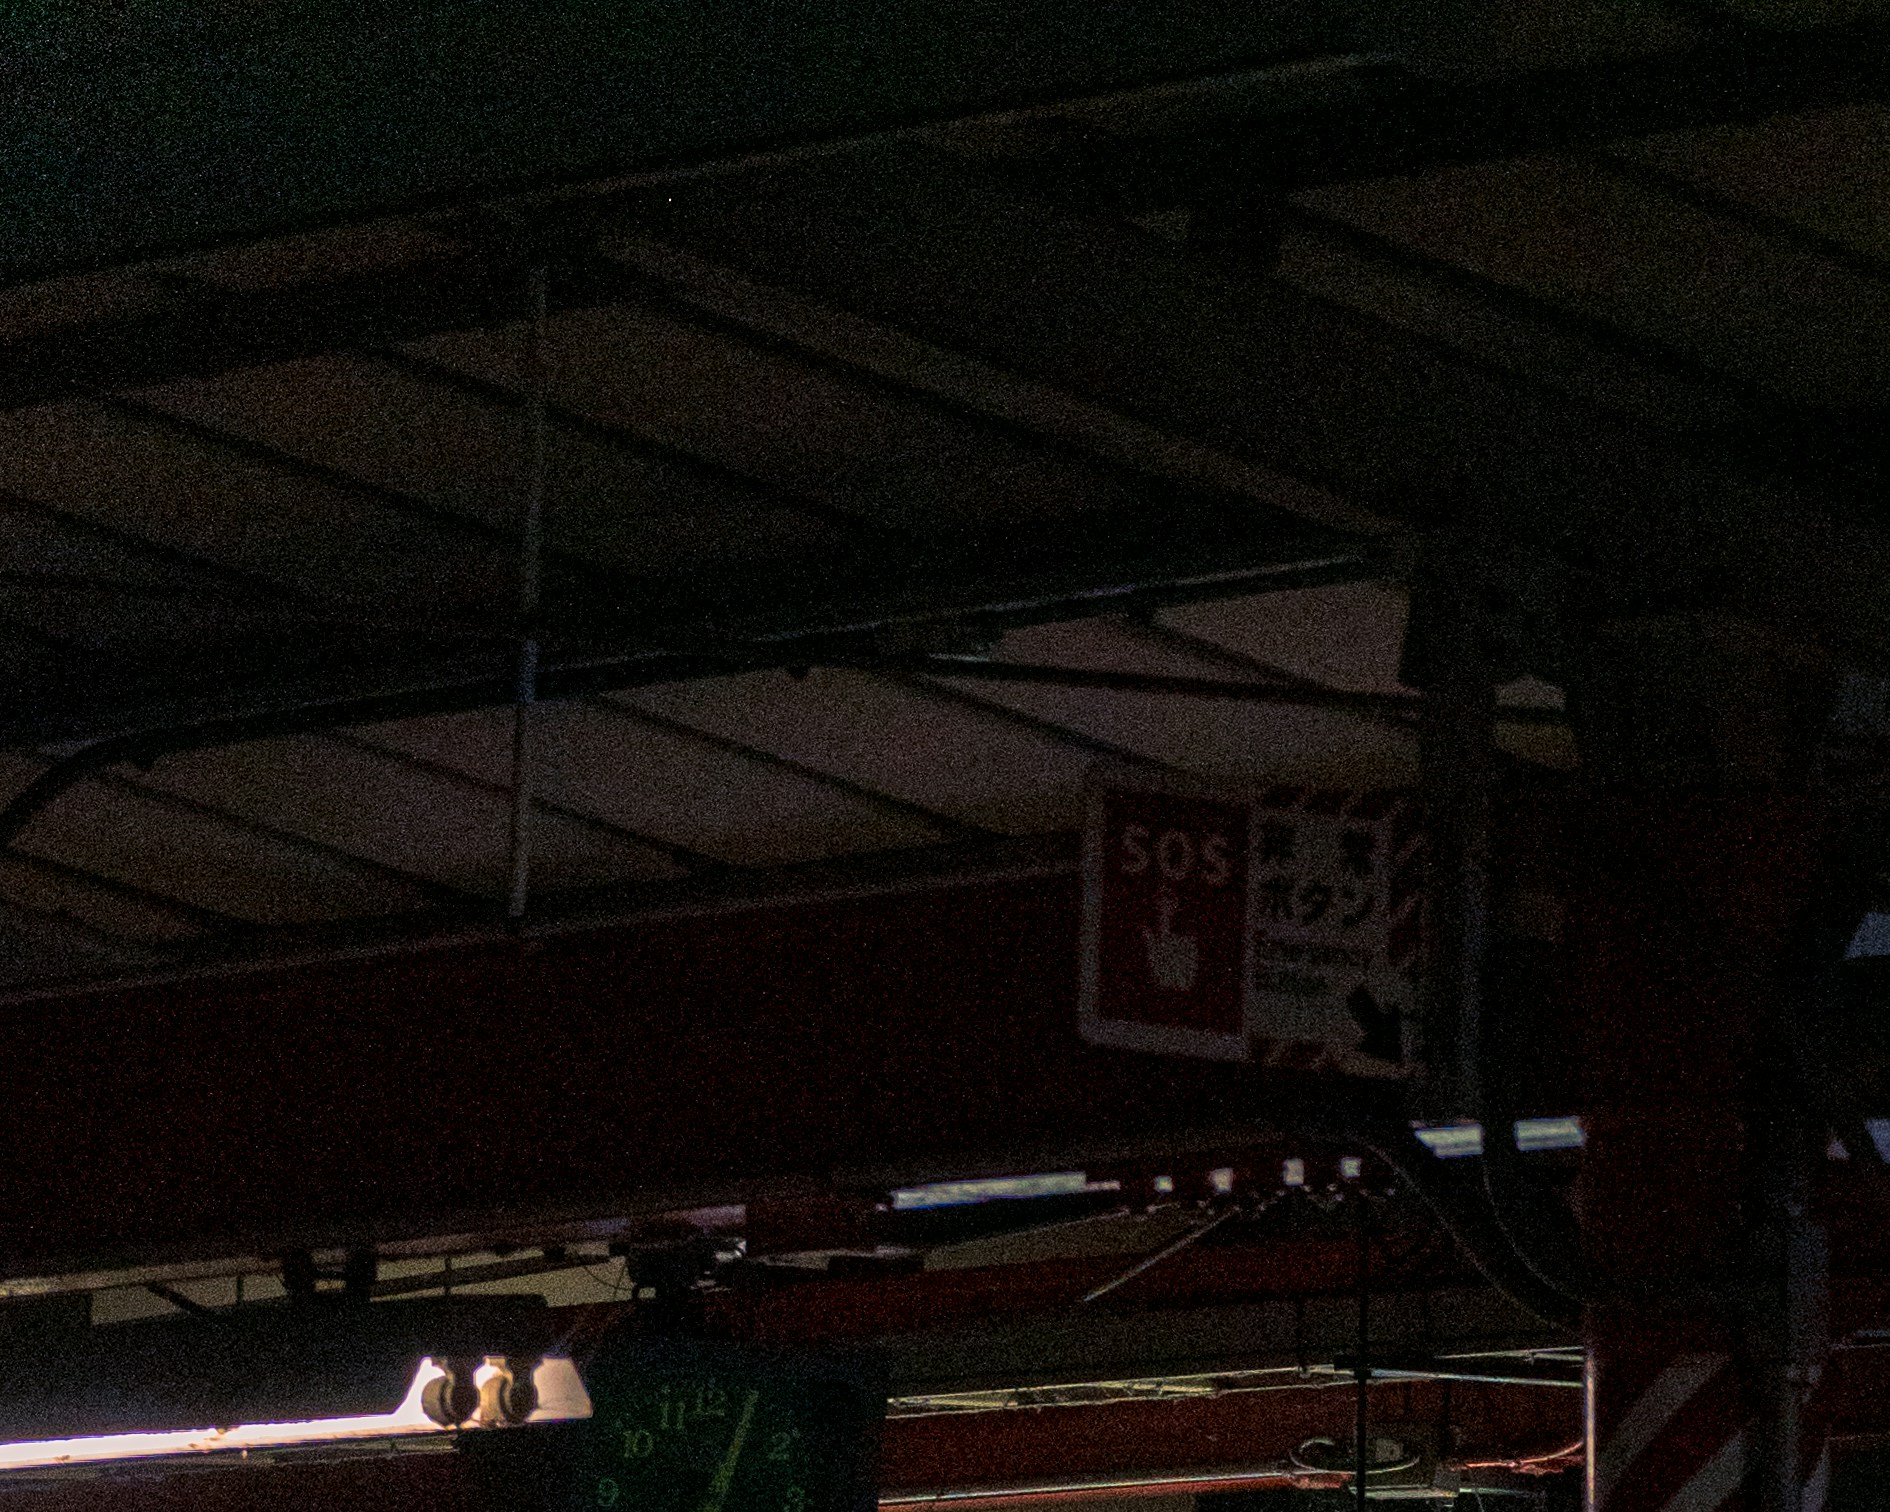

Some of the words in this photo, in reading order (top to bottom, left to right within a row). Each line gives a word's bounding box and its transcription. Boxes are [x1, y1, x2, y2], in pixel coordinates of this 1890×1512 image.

[1121, 824, 1230, 886] SOS
[1262, 878, 1373, 926] ボタン
[622, 1430, 654, 1458] 10
[767, 1432, 791, 1461] 2
[598, 1478, 620, 1507] 9
